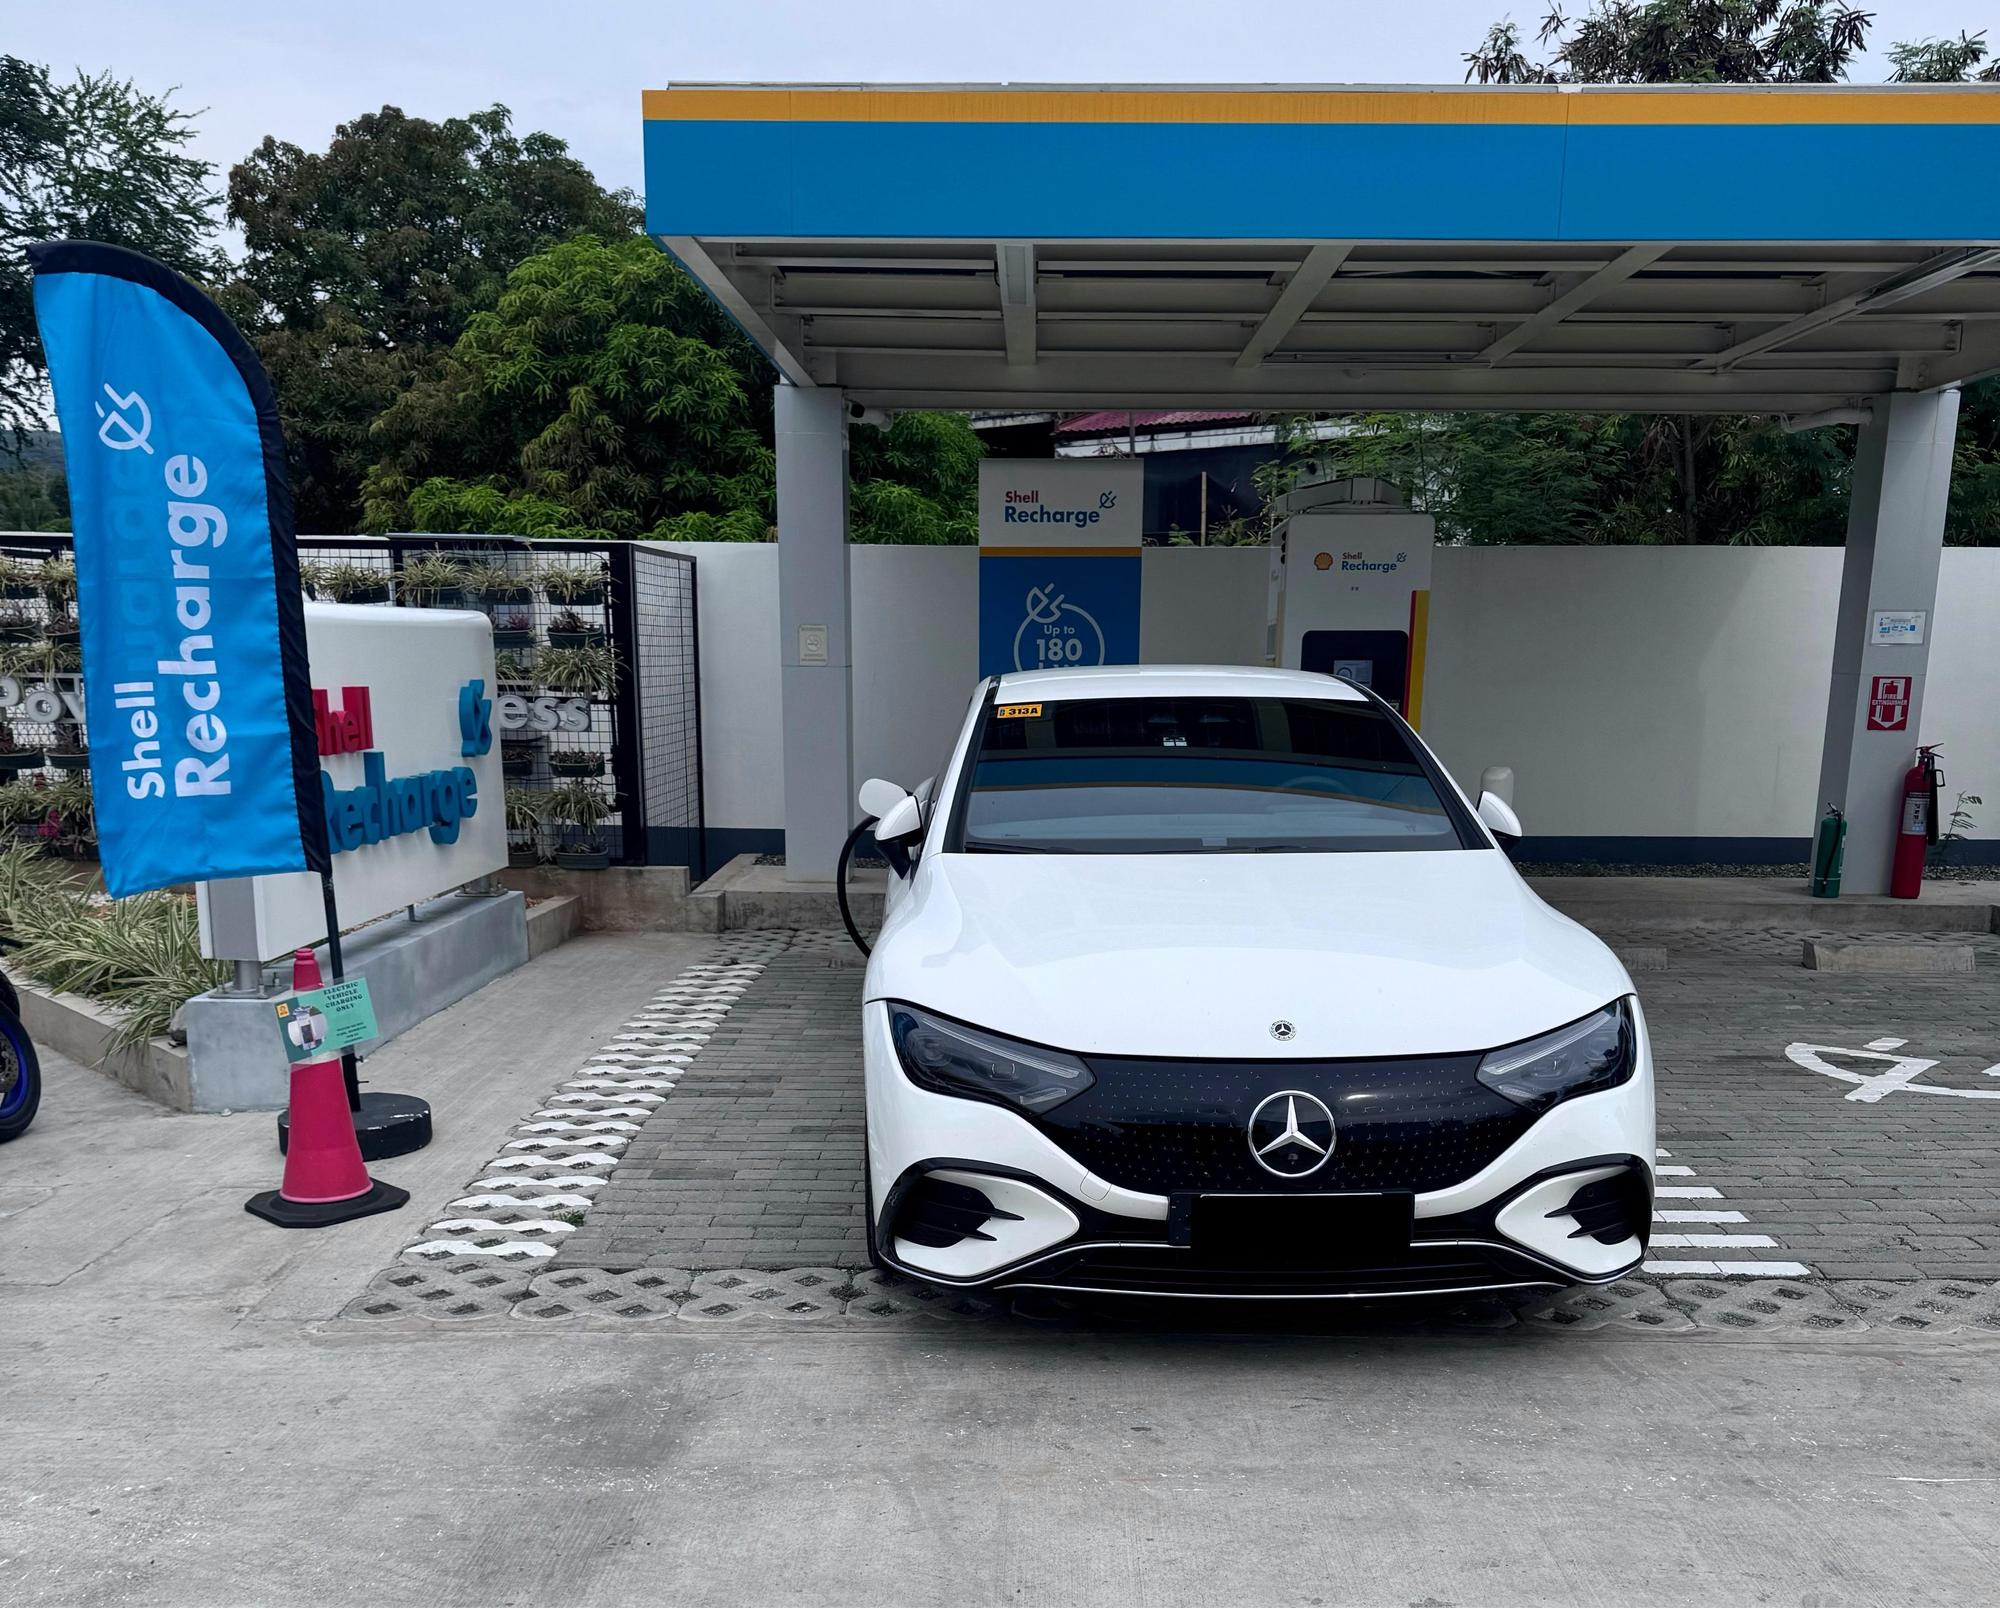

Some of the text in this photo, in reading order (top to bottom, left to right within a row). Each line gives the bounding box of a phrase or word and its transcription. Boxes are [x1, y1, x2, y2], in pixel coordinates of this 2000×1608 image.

[1005, 490, 1039, 503] Shell
[1004, 505, 1100, 528] Recharge
[1342, 552, 1362, 560] Shell
[1341, 560, 1397, 573] Recharge
[157, 454, 231, 798] Recharge
[1043, 625, 1075, 637] Up to
[1036, 639, 1083, 661] 180
[114, 681, 165, 800] Shell
[323, 981, 359, 995] ELECTRIC
[326, 988, 358, 1001] VEHICLE
[325, 994, 363, 1008] CHARGING
[336, 1003, 355, 1012] ONLY
